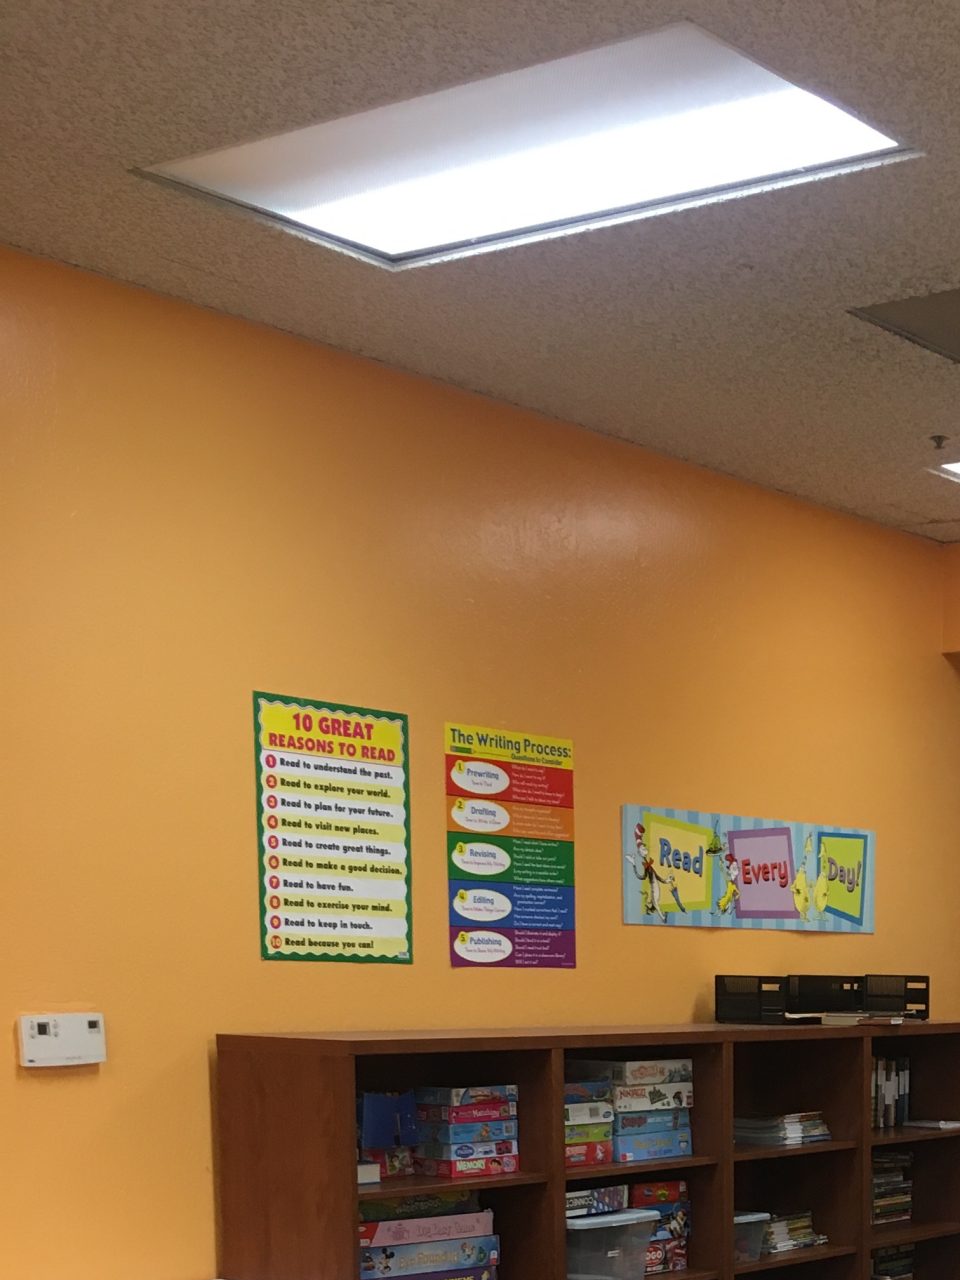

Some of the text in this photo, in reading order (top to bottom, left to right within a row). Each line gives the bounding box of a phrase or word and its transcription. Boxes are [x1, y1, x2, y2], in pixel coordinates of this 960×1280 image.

[293, 713, 374, 740] 10 GREAT
[268, 733, 396, 762] REASONS TO READ
[450, 728, 571, 758] The Writing Process:
[280, 758, 300, 768] Read
[303, 760, 311, 769] to
[314, 761, 358, 775] understand
[360, 768, 371, 777] the
[374, 770, 393, 779] past.
[467, 768, 499, 780] Prewriting
[280, 778, 301, 788] Read
[303, 780, 311, 789] to
[314, 781, 344, 793] explore
[347, 787, 364, 795] your
[366, 788, 391, 798] world.
[281, 798, 301, 808] Read
[304, 801, 311, 809] to
[314, 802, 332, 811] plan
[334, 804, 346, 813] for
[348, 807, 365, 816] your
[368, 806, 394, 818] future.
[471, 807, 496, 817] Drafting
[281, 818, 302, 828] Read
[304, 820, 312, 829] to
[315, 822, 332, 831] visit
[353, 825, 379, 835] places.
[282, 838, 302, 847] Read
[305, 839, 313, 848] to
[316, 842, 340, 850] create
[343, 844, 363, 853] great
[365, 846, 391, 857] things.
[470, 849, 496, 859] Revising
[282, 858, 303, 868] Read
[305, 859, 314, 868] to
[316, 861, 338, 870] make
[348, 863, 367, 873] good
[370, 864, 402, 875] decision.
[659, 838, 862, 893] Read Every Day!
[283, 879, 303, 888] Read
[306, 880, 314, 889] to
[317, 881, 335, 891] have
[338, 882, 354, 892] fun.
[284, 898, 304, 907] Read
[307, 899, 314, 908] to
[318, 901, 349, 910] exercise
[352, 904, 368, 912] your
[371, 904, 392, 912] mind.
[473, 896, 494, 905] Editing
[284, 918, 304, 927] Read
[307, 919, 315, 927] to
[318, 919, 338, 930] keep
[340, 920, 348, 928] in
[350, 921, 373, 930] touch.
[285, 938, 305, 946] Read
[308, 938, 339, 948] because
[342, 940, 355, 949] you
[358, 940, 374, 948] can!
[470, 937, 501, 946] Publishing
